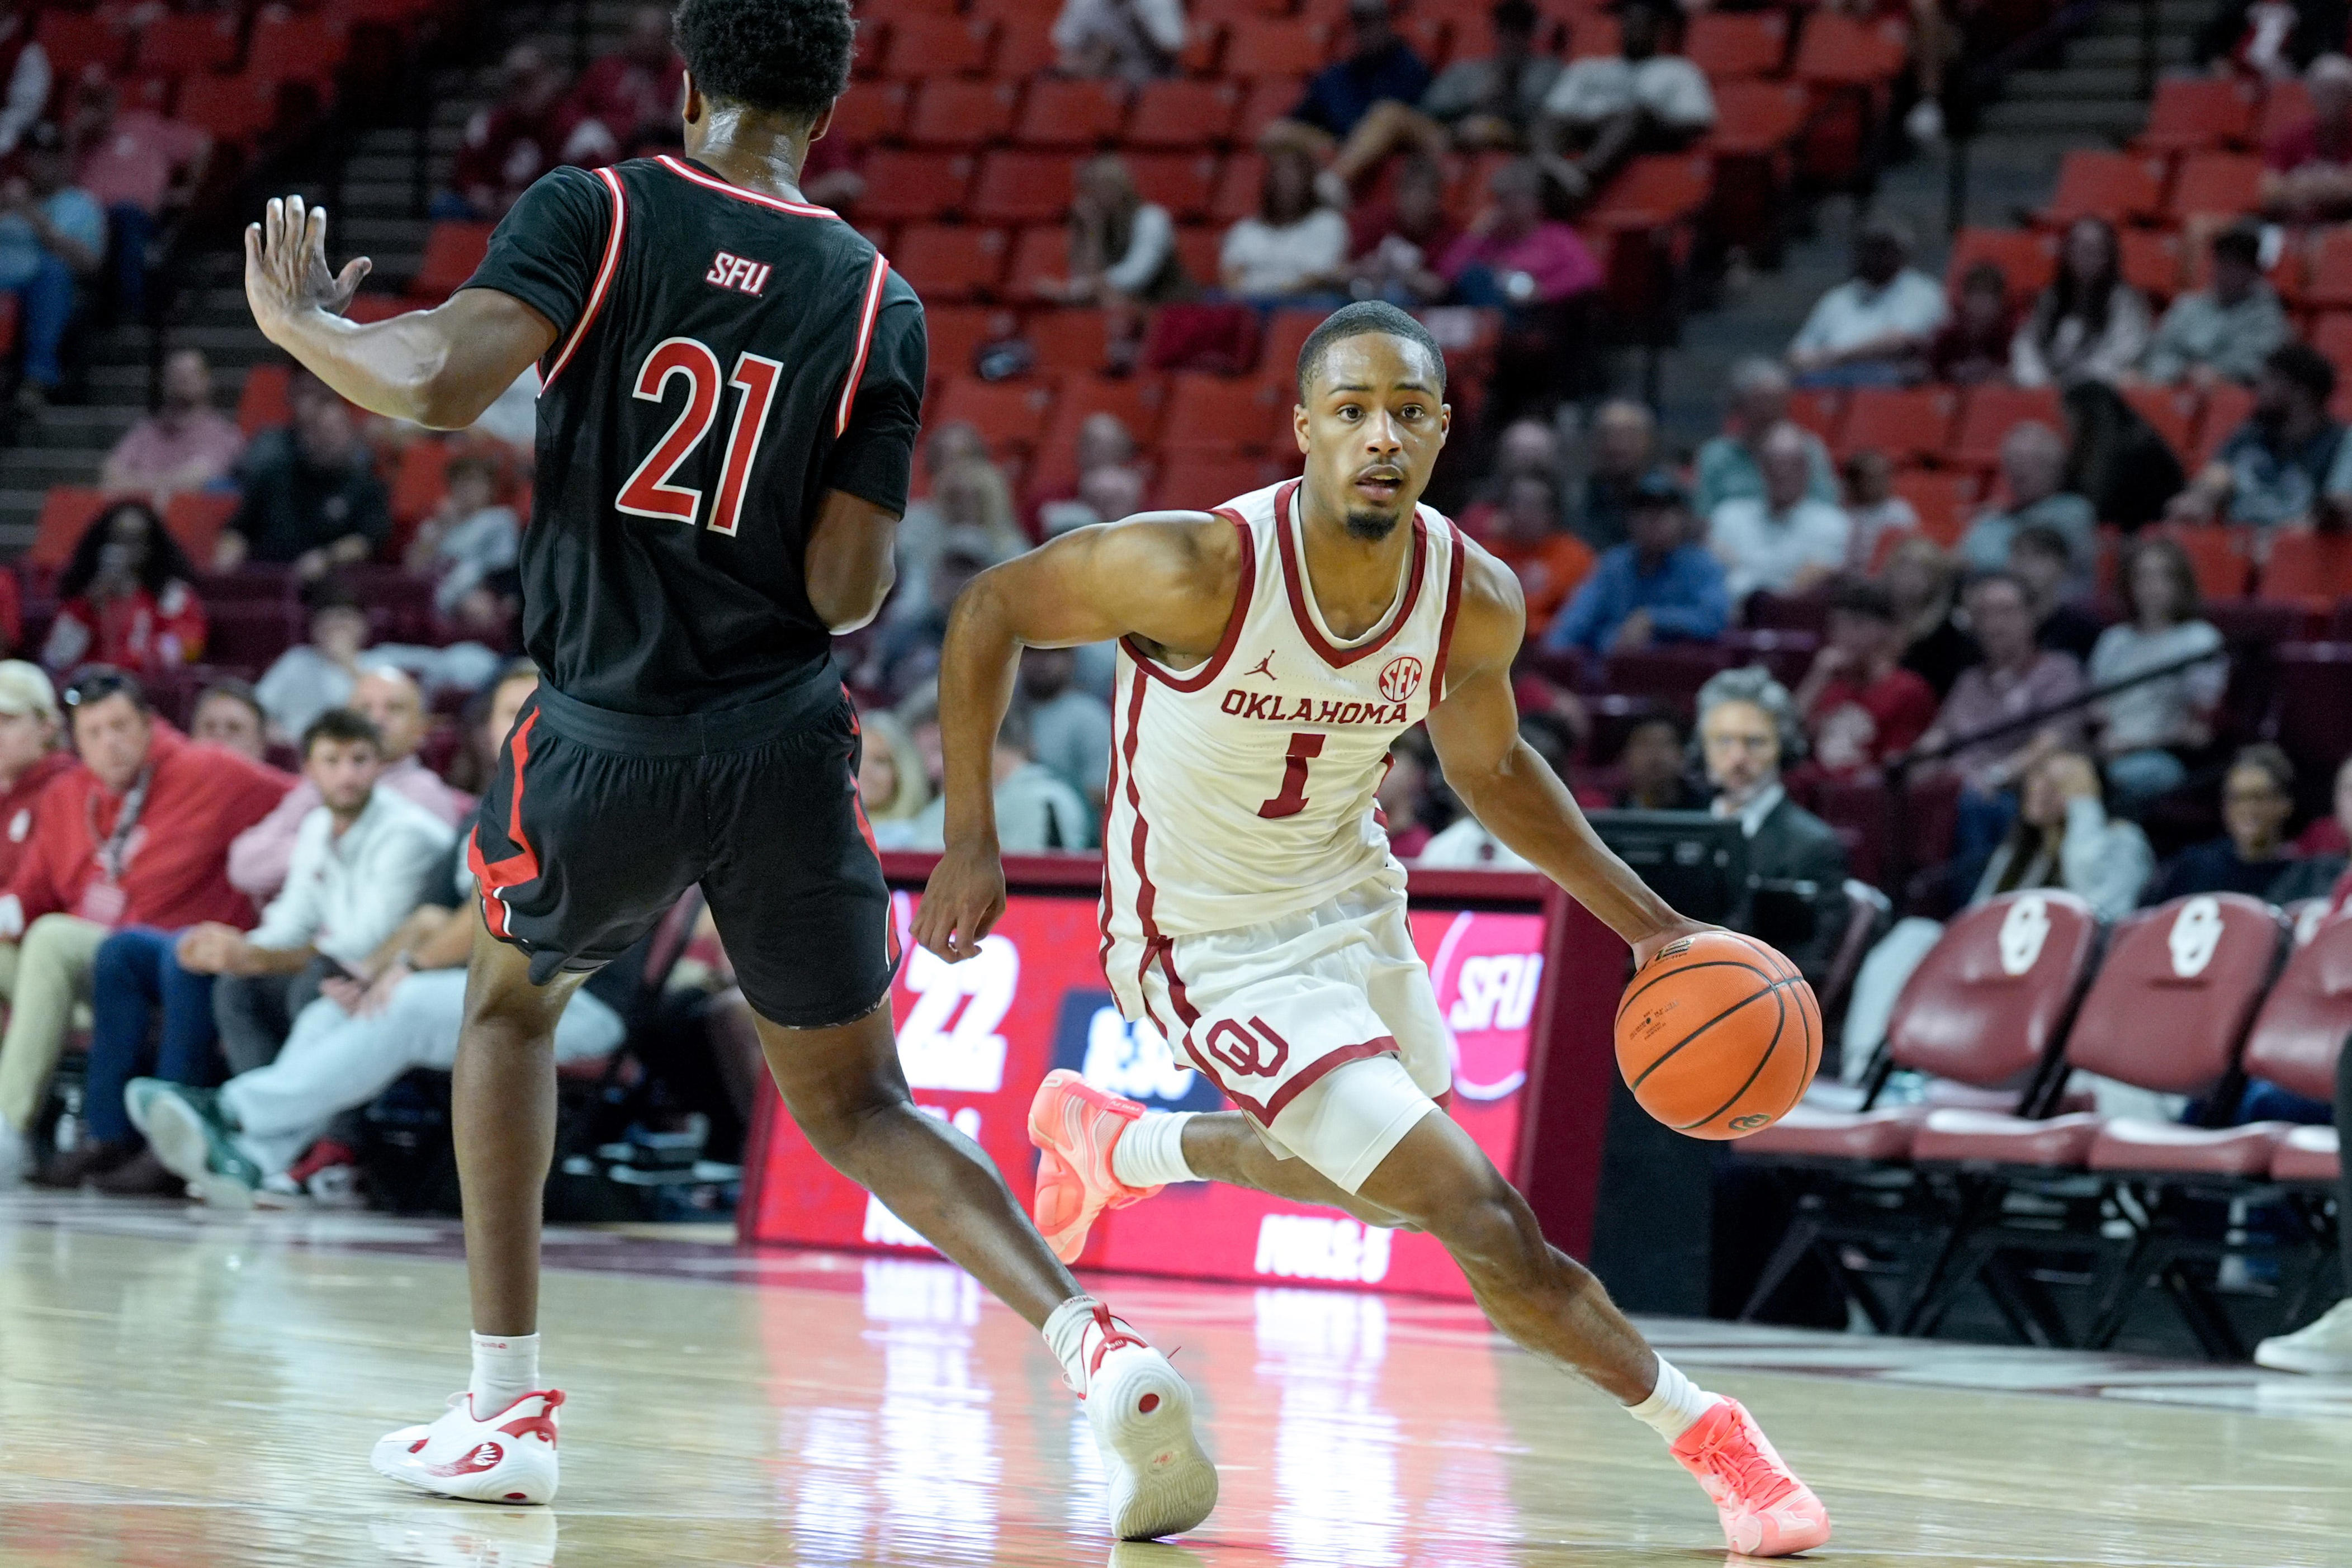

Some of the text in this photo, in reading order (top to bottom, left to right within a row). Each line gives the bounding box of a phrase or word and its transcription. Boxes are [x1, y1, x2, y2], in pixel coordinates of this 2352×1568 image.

[706, 249, 772, 295] SFU
[615, 337, 783, 537] 21
[1220, 689, 1407, 724] OKLAHOMA
[1381, 658, 1422, 700] SEC
[1257, 732, 1326, 818] 1
[895, 934, 1019, 1093] 22
[1449, 954, 1544, 1030] SFU
[1205, 1015, 1289, 1078] OU
